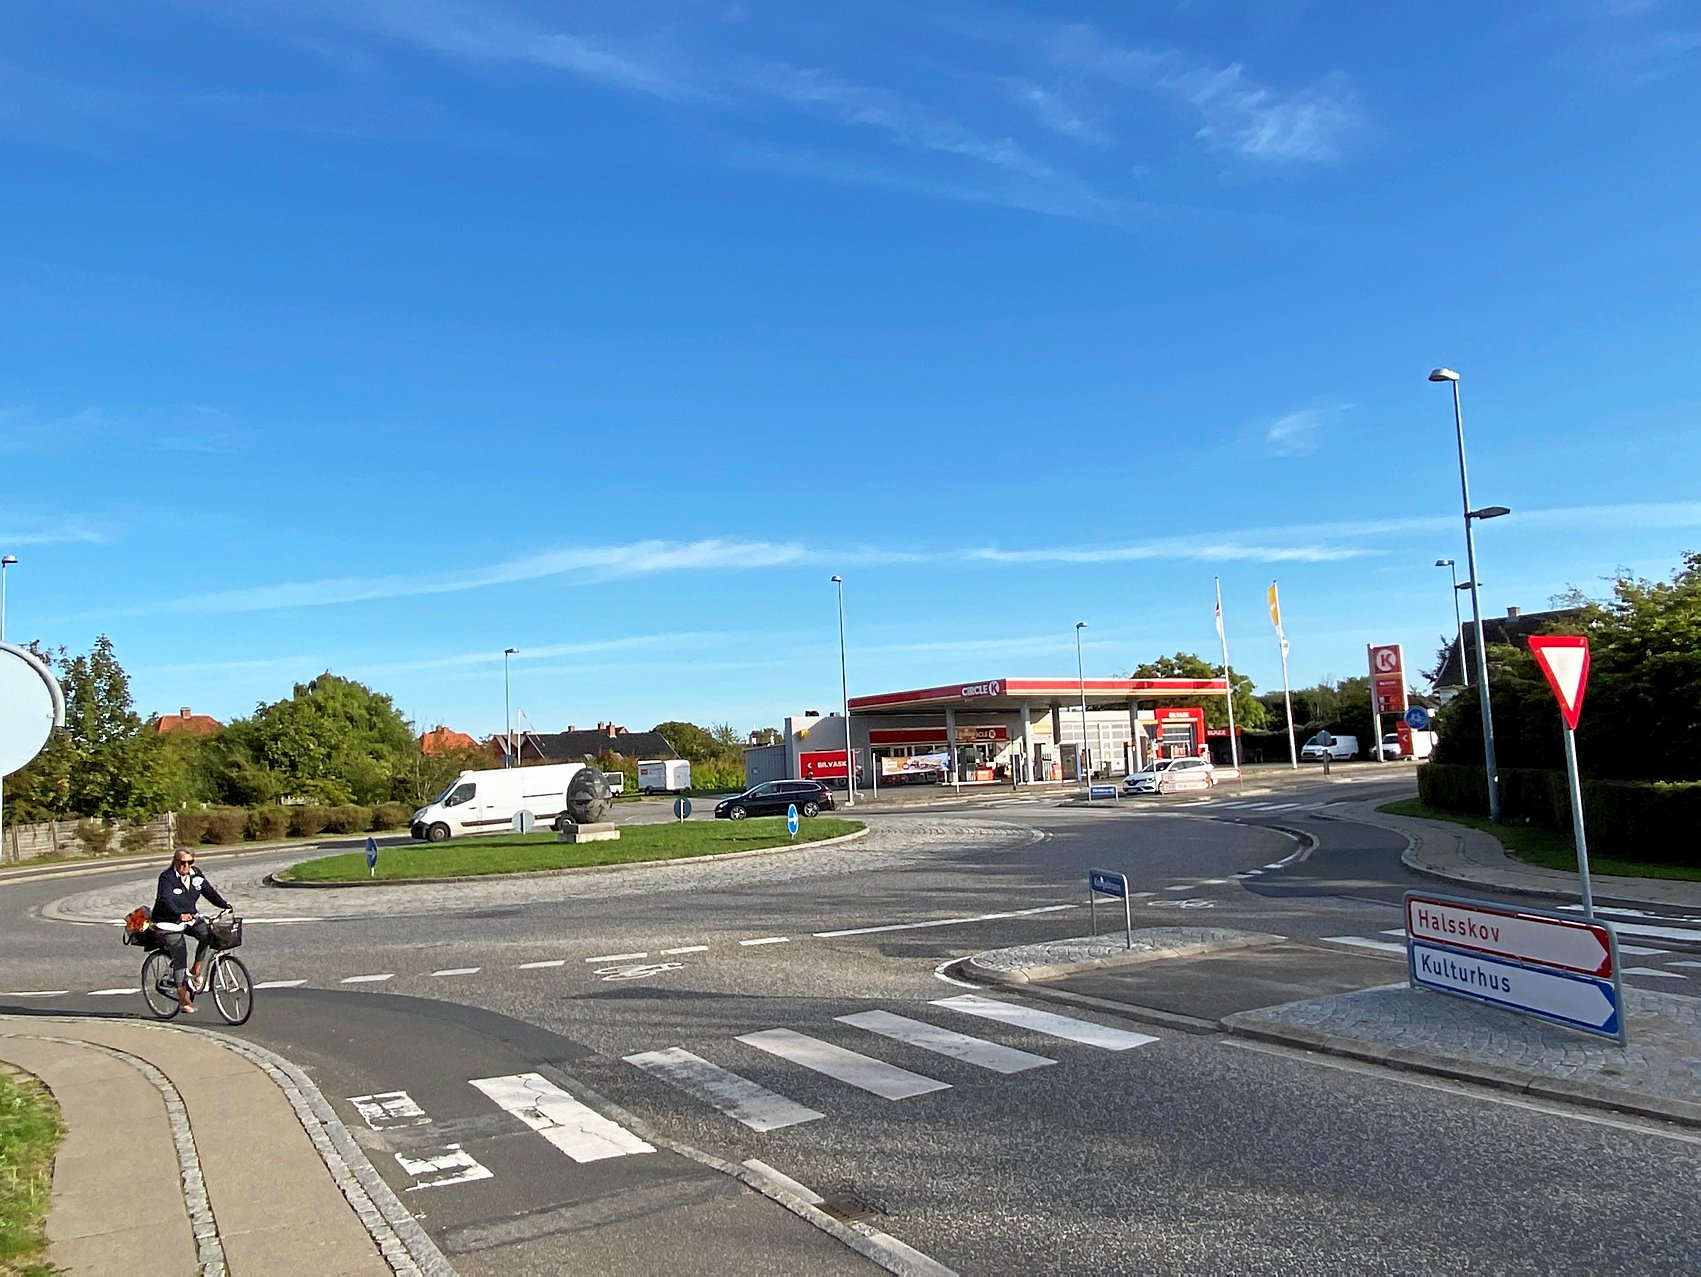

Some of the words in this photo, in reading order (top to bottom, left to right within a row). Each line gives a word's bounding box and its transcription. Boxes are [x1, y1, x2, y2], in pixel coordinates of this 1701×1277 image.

[1379, 651, 1396, 669] K
[961, 684, 988, 696] CIRCLE
[989, 681, 1000, 696] K
[817, 760, 848, 769] BILVASK
[1418, 908, 1500, 943] Halsskov
[1421, 953, 1511, 992] Kulturhus
